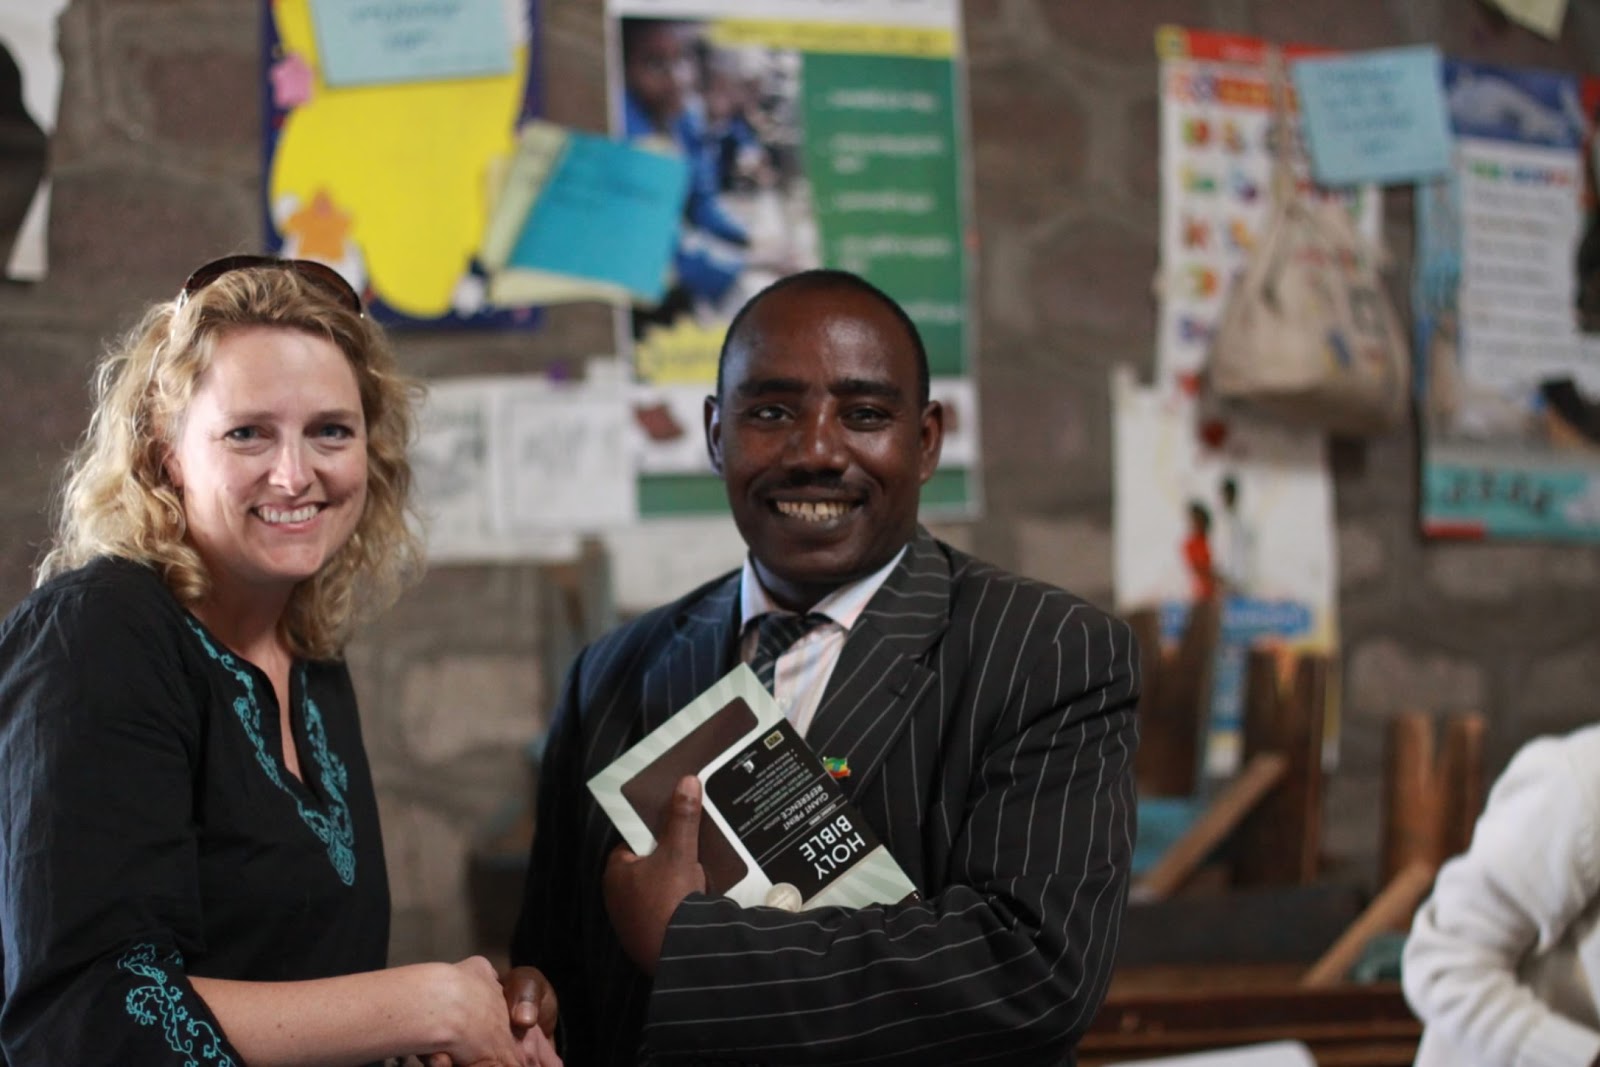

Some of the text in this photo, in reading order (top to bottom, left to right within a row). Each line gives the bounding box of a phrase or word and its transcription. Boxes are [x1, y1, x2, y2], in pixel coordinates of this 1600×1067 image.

[779, 783, 824, 820] REFERENCE
[781, 791, 829, 830] GIANT PRINT
[798, 813, 853, 862] BIBLE
[810, 830, 866, 880] HOLY
